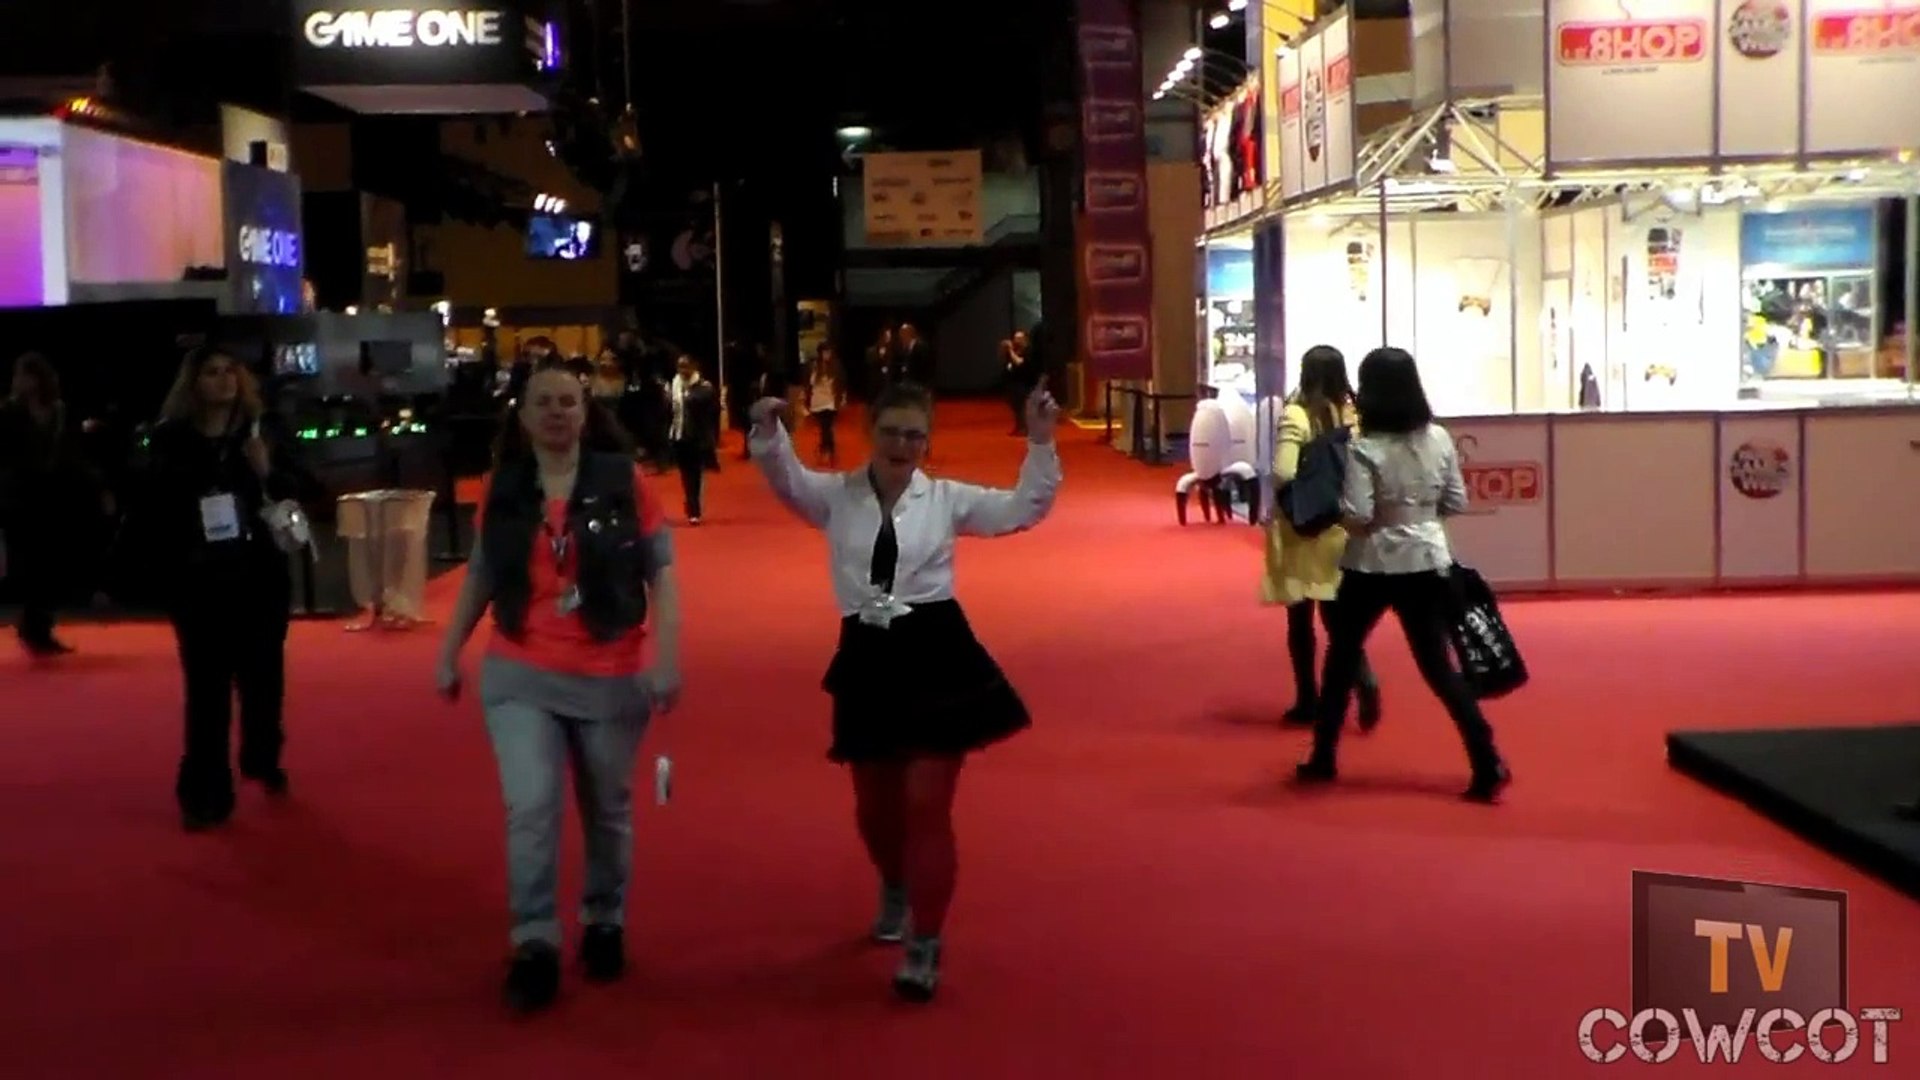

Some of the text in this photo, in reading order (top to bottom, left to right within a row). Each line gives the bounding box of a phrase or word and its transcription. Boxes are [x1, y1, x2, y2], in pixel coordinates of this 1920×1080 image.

[304, 9, 502, 47] GAME ONE
[1589, 24, 1700, 62] SHOP
[1847, 12, 1920, 54] SHO
